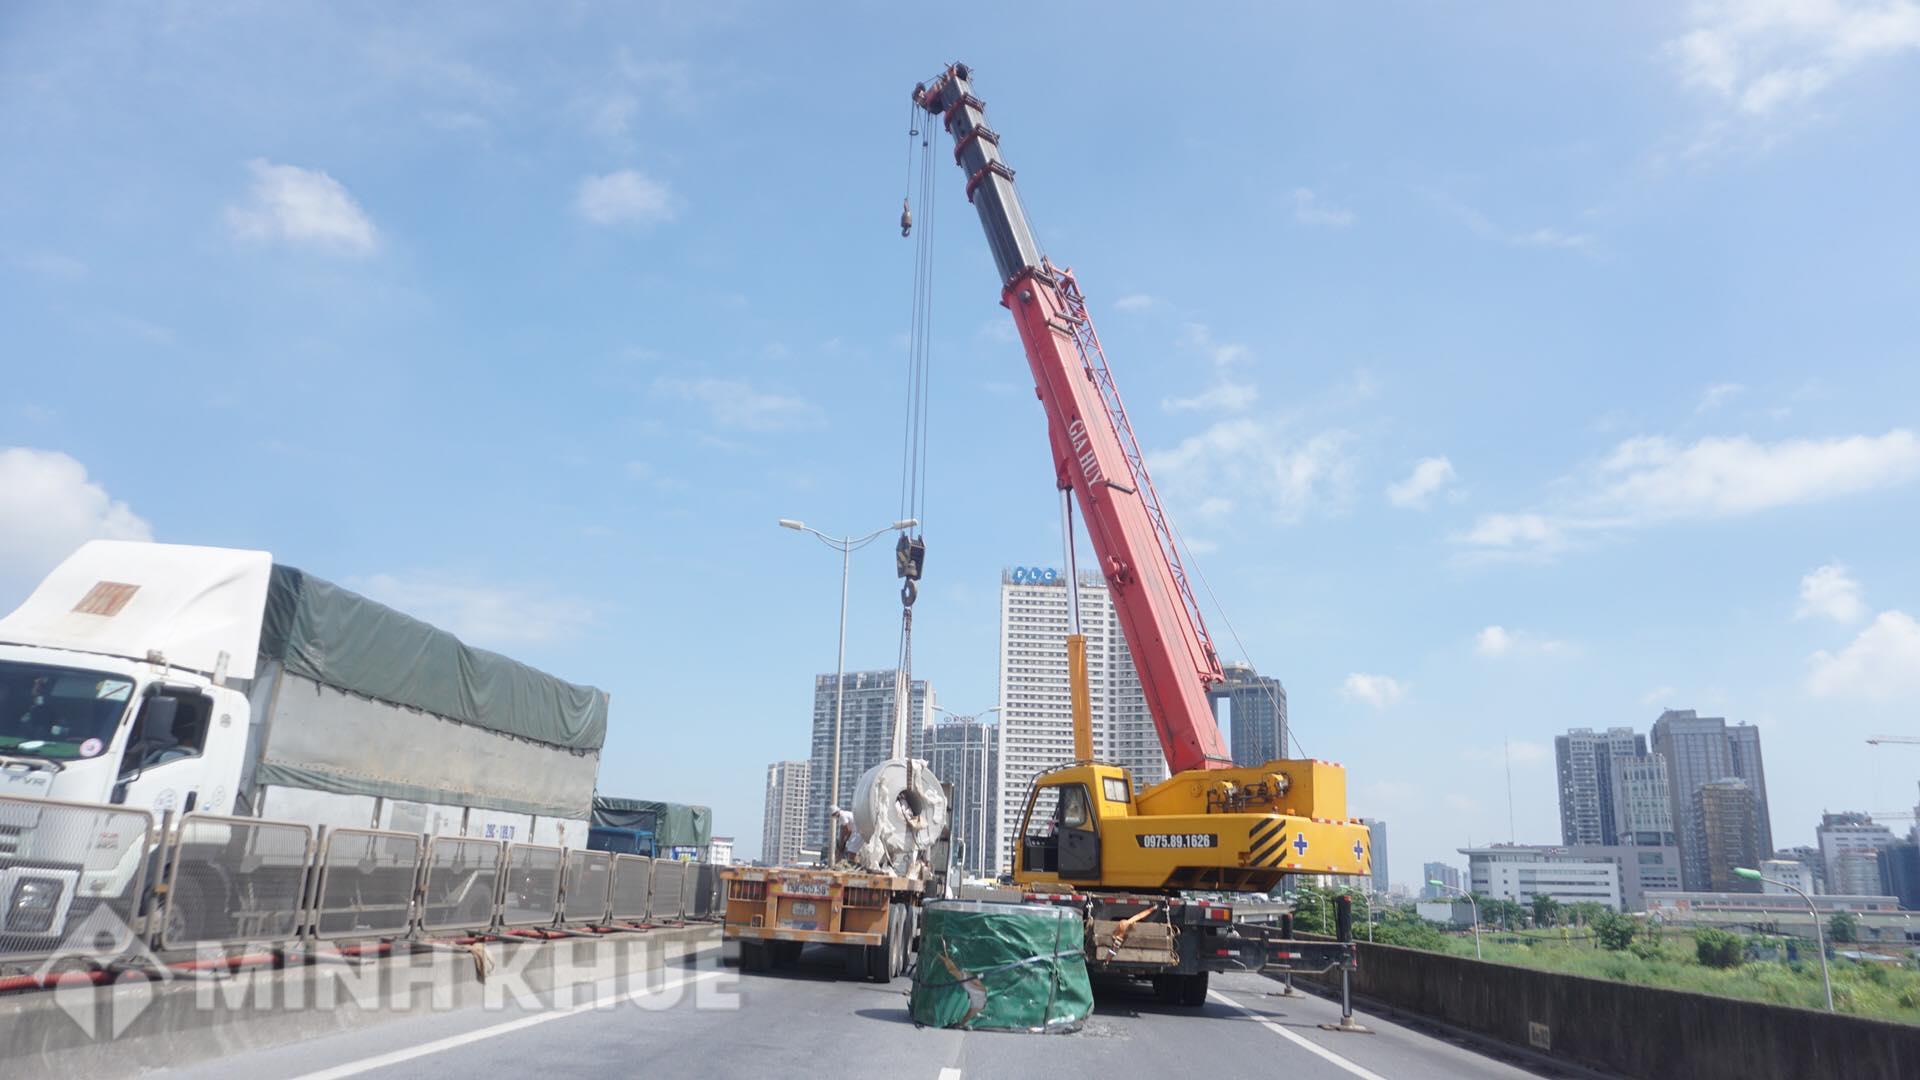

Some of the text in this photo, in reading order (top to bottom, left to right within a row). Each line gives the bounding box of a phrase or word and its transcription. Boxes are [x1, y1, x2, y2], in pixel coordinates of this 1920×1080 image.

[1069, 420, 1104, 489] GIA HUY
[1016, 569, 1054, 581] FLC
[1144, 835, 1210, 848] 0975.89.1626
